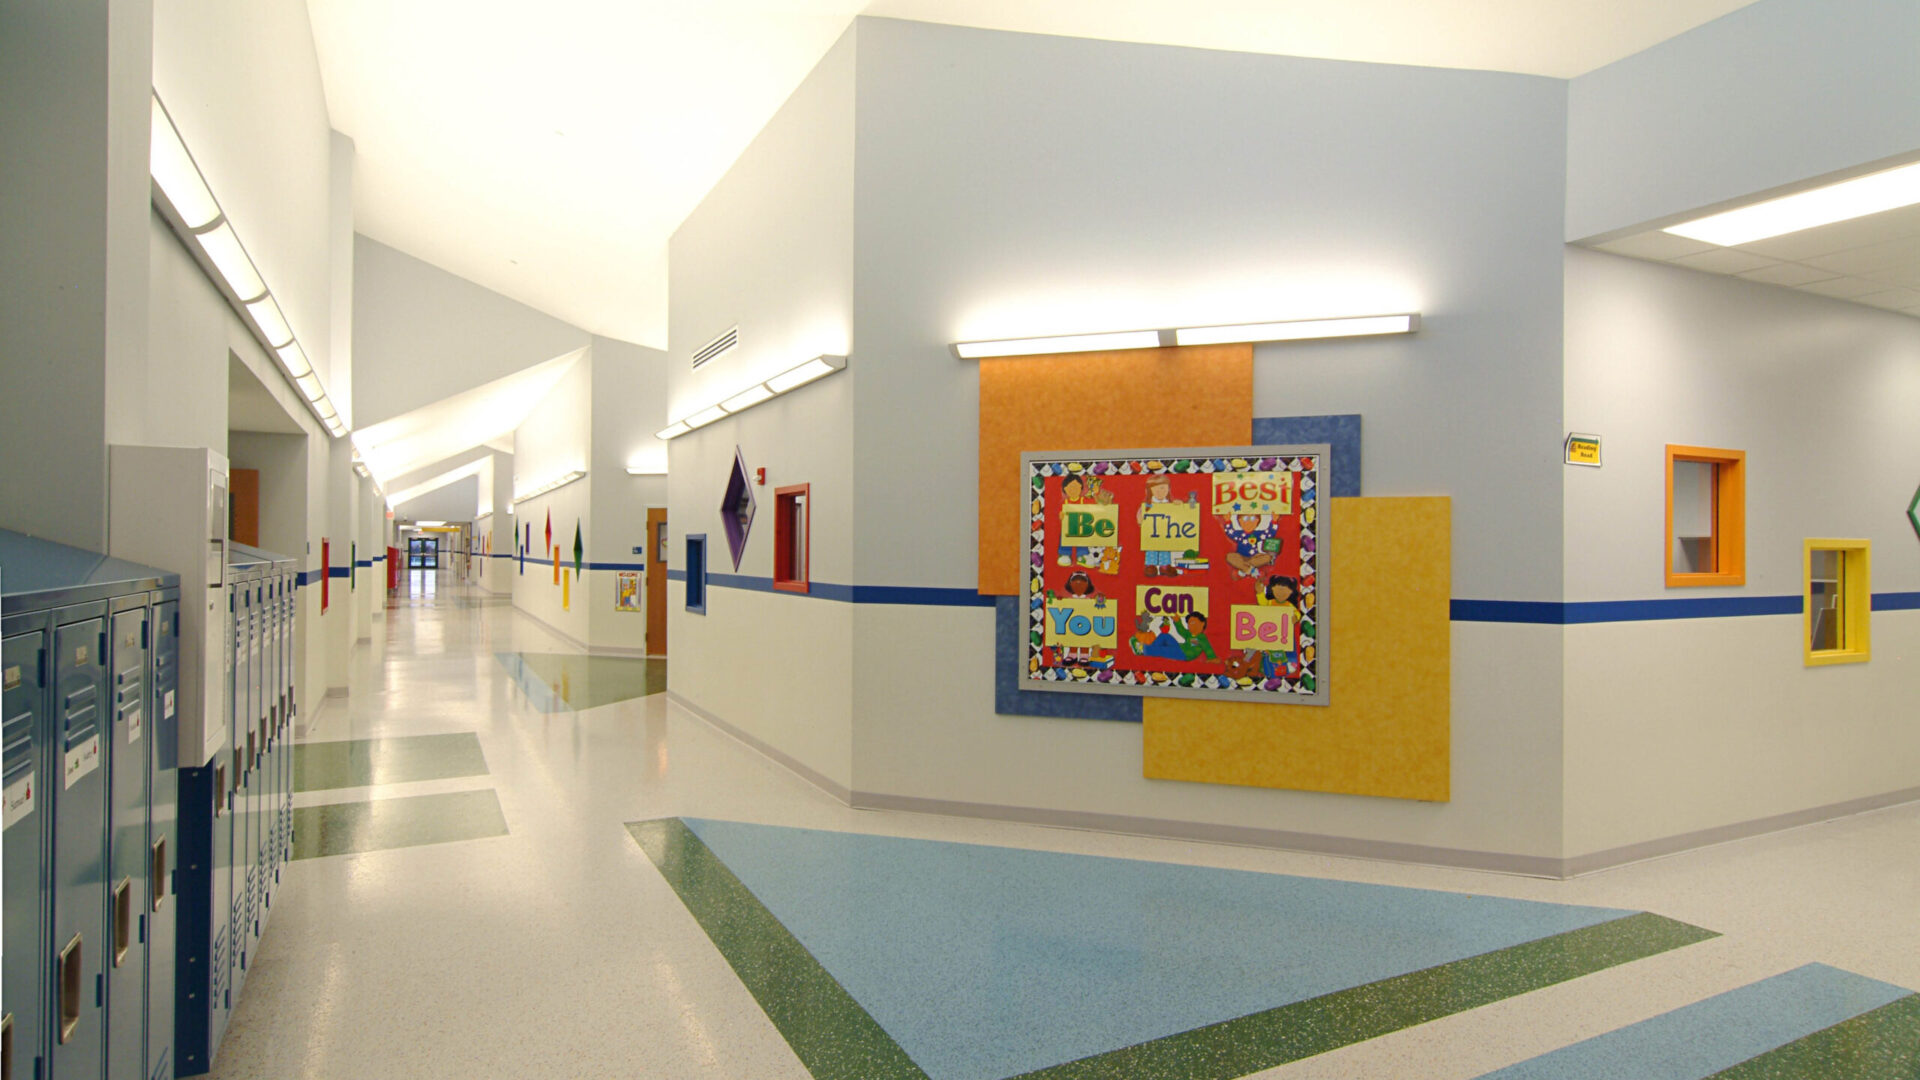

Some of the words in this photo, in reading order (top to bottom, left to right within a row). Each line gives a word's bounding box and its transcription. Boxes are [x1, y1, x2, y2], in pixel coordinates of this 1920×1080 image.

[1065, 511, 1115, 538] Be
[1143, 513, 1197, 539] The
[1215, 477, 1291, 505] Best
[1048, 607, 1116, 637] You
[1144, 587, 1194, 614] Can
[1235, 611, 1289, 645] Be!
